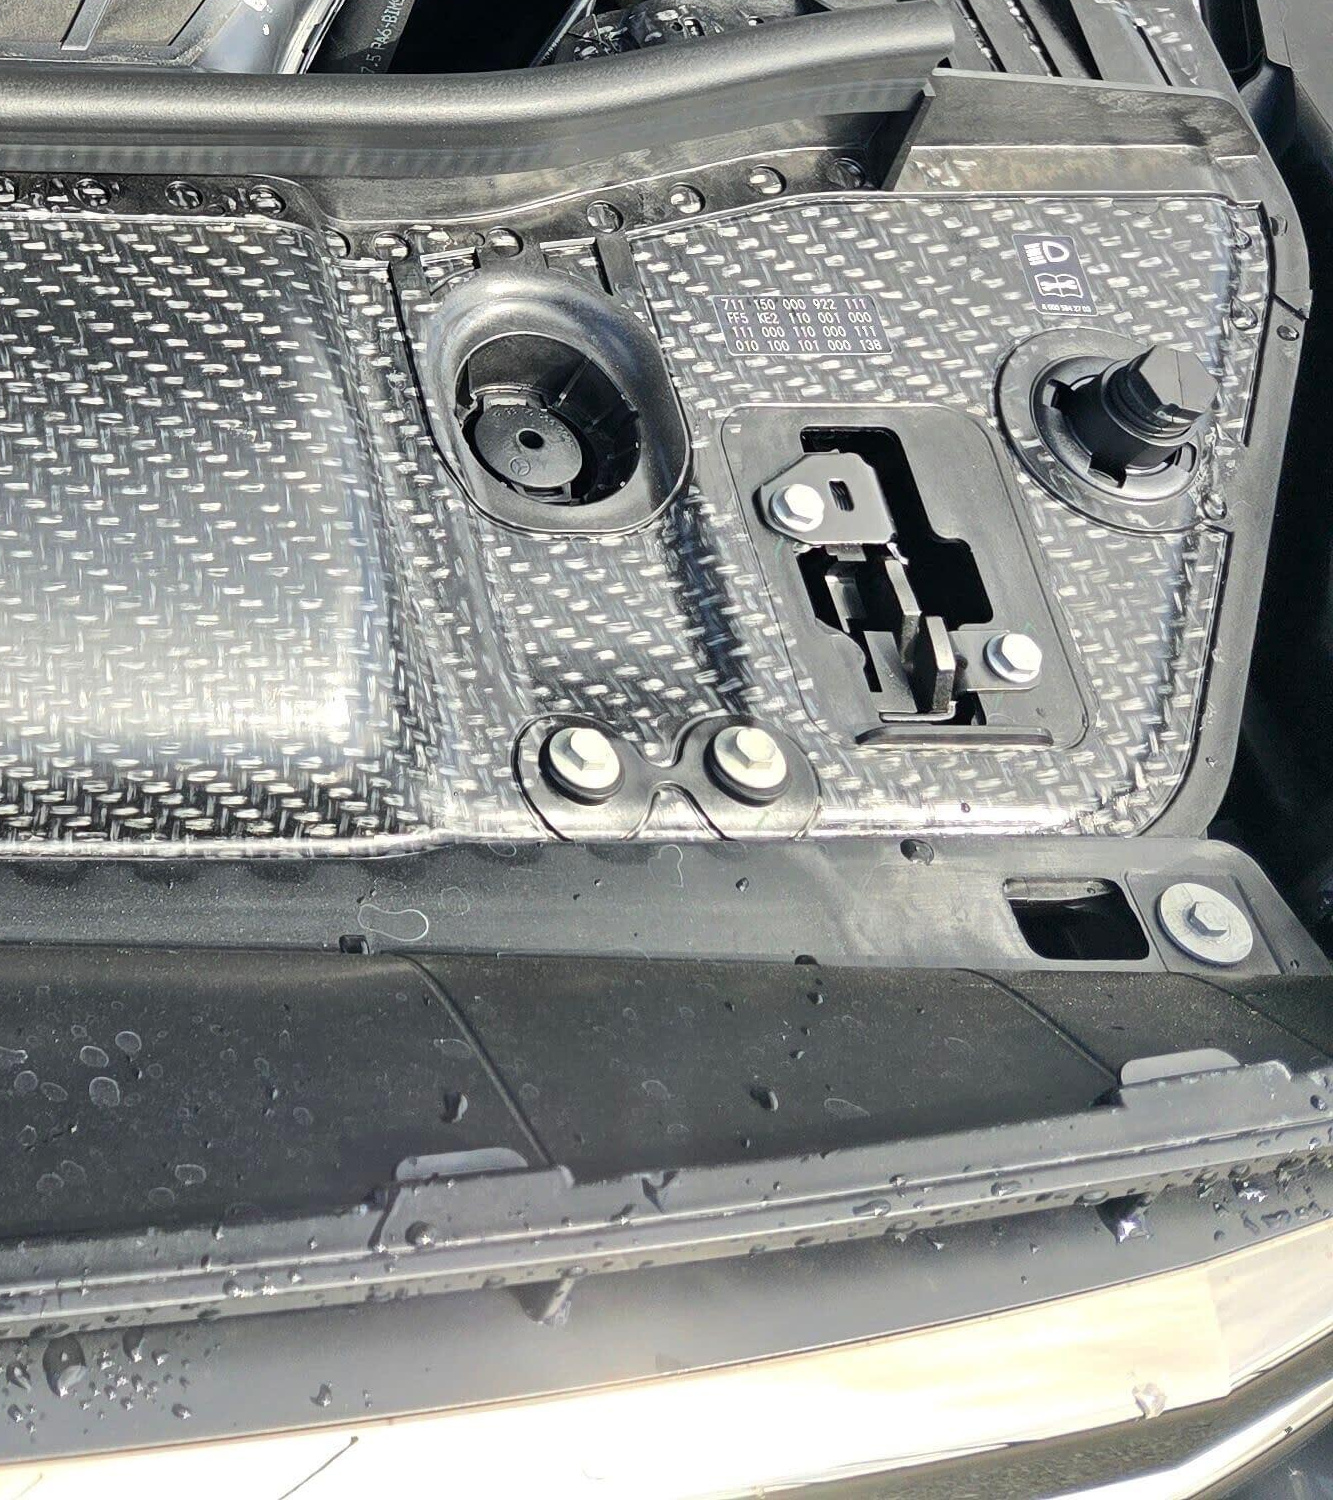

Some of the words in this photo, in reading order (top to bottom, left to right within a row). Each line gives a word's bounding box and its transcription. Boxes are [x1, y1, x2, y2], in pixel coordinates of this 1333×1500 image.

[720, 298, 746, 311] 711
[753, 298, 776, 311] 150
[782, 298, 807, 311] 000
[812, 298, 837, 311] 922
[844, 298, 868, 310] 111
[727, 312, 749, 324] FF5
[756, 312, 780, 325] KE2
[788, 312, 811, 324] 110
[817, 312, 841, 324] 001
[848, 312, 873, 323] 000
[732, 326, 755, 338] 111
[761, 326, 786, 338] 000
[793, 326, 816, 338] 110
[822, 326, 847, 338] 000
[854, 326, 878, 338] 111
[735, 340, 759, 352] 010
[767, 340, 790, 352] 100
[797, 340, 820, 351] 101
[827, 340, 852, 351] 000
[859, 339, 883, 351] 138
